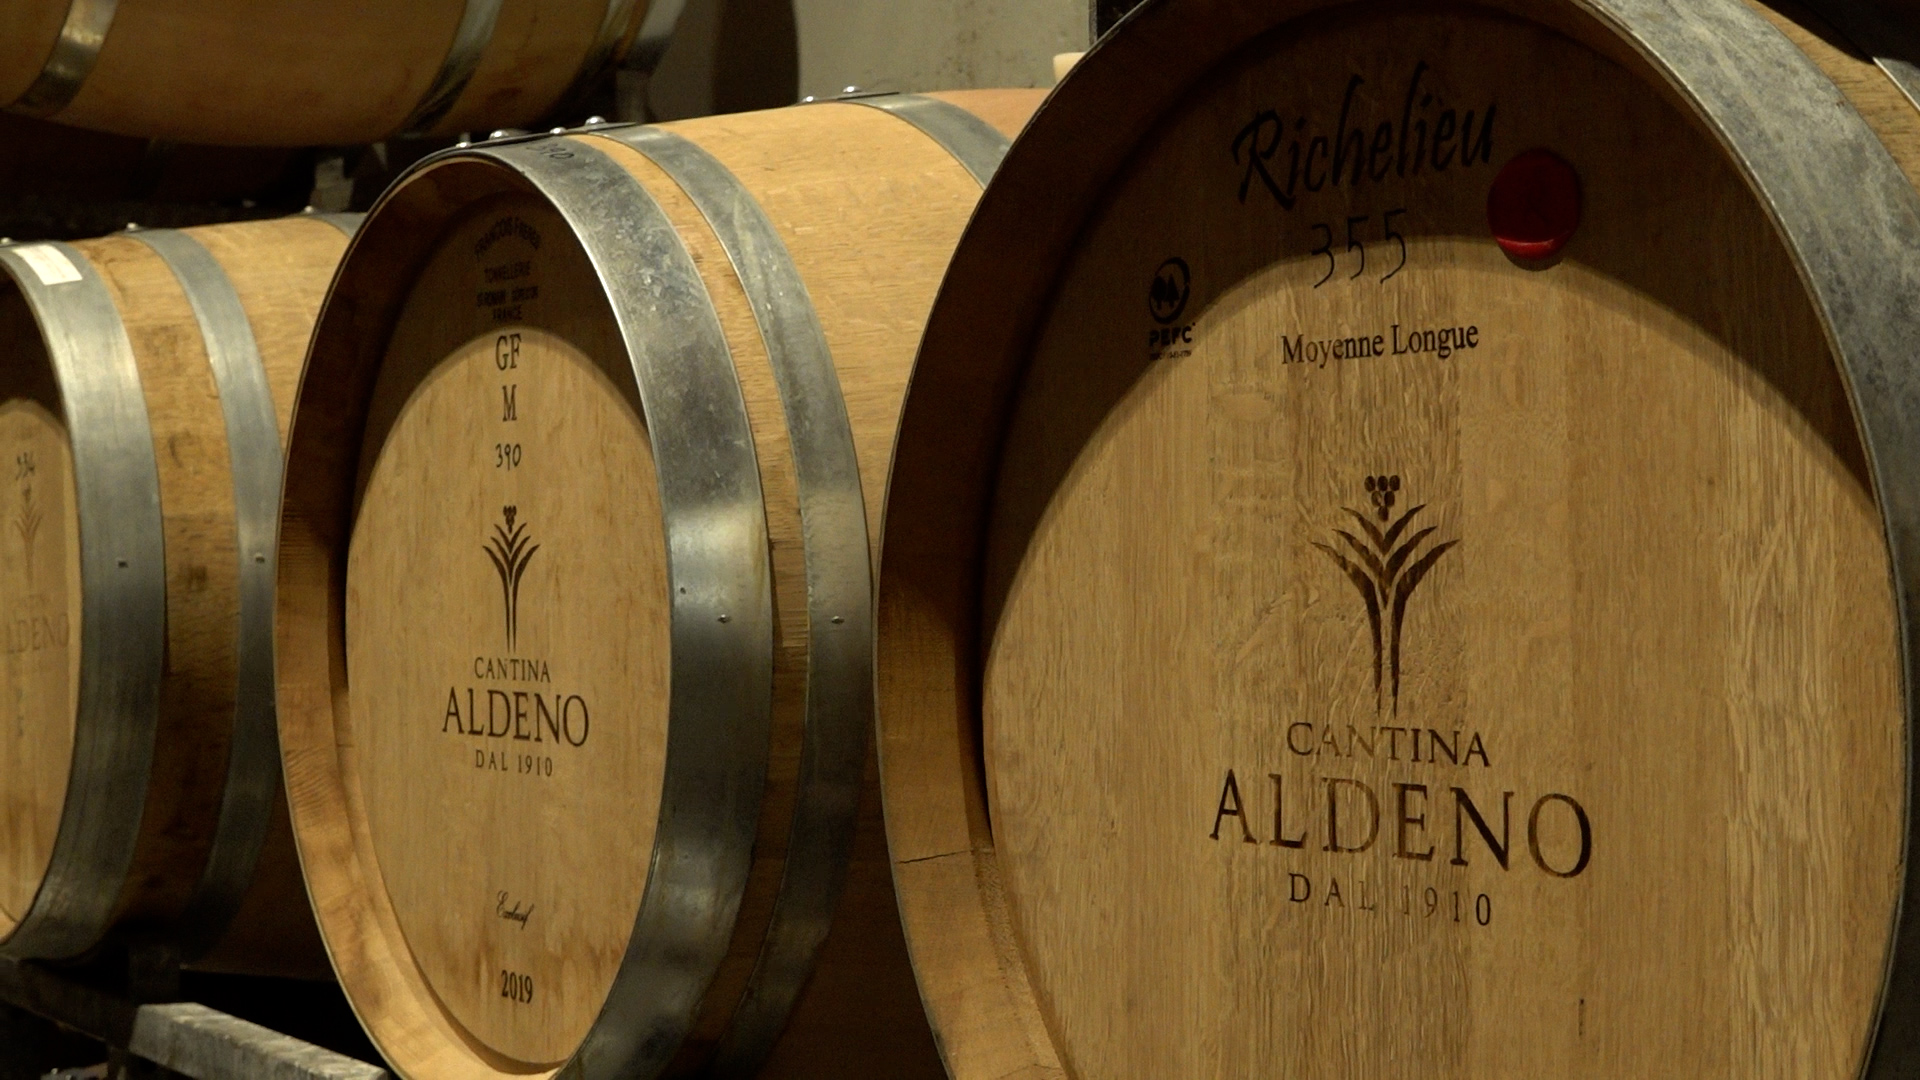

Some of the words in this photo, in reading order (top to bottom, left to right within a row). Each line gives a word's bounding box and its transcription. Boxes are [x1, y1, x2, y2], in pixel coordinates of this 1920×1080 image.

[1231, 60, 1496, 210] Richelieu
[1311, 209, 1406, 288] 355
[496, 333, 521, 370] GF
[1150, 326, 1191, 346] PEFC
[1281, 333, 1384, 368] Moyenne
[1391, 324, 1479, 358] Longue
[502, 384, 517, 421] M
[496, 444, 521, 470] 390
[474, 657, 551, 683] CANTINA
[443, 686, 589, 747] ALDENO
[476, 750, 507, 771] DAL
[518, 755, 552, 776] 1910
[1287, 722, 1490, 767] CANTINA
[1210, 769, 1592, 878] ALDENO
[1288, 873, 1375, 910] DAL
[1404, 885, 1491, 925] 1910
[501, 969, 533, 1004] 2019
